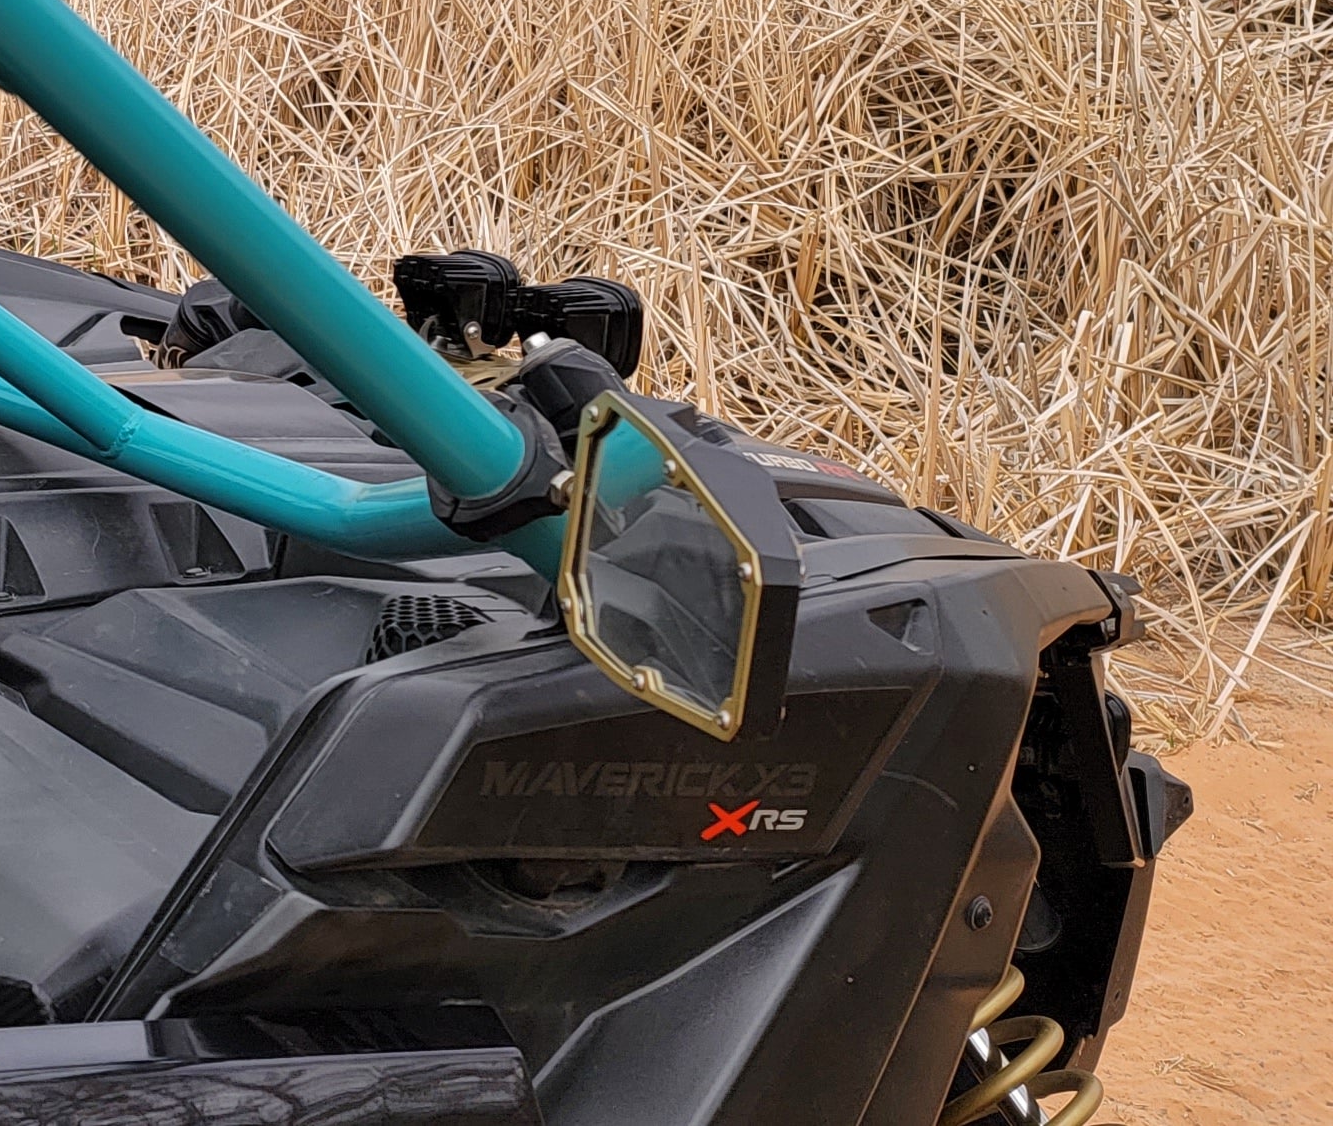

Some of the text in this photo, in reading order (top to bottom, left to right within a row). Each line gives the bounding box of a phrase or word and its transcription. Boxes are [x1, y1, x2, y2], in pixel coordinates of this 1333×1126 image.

[480, 760, 819, 798] MAVERICK X3
[699, 799, 809, 842] XRS
